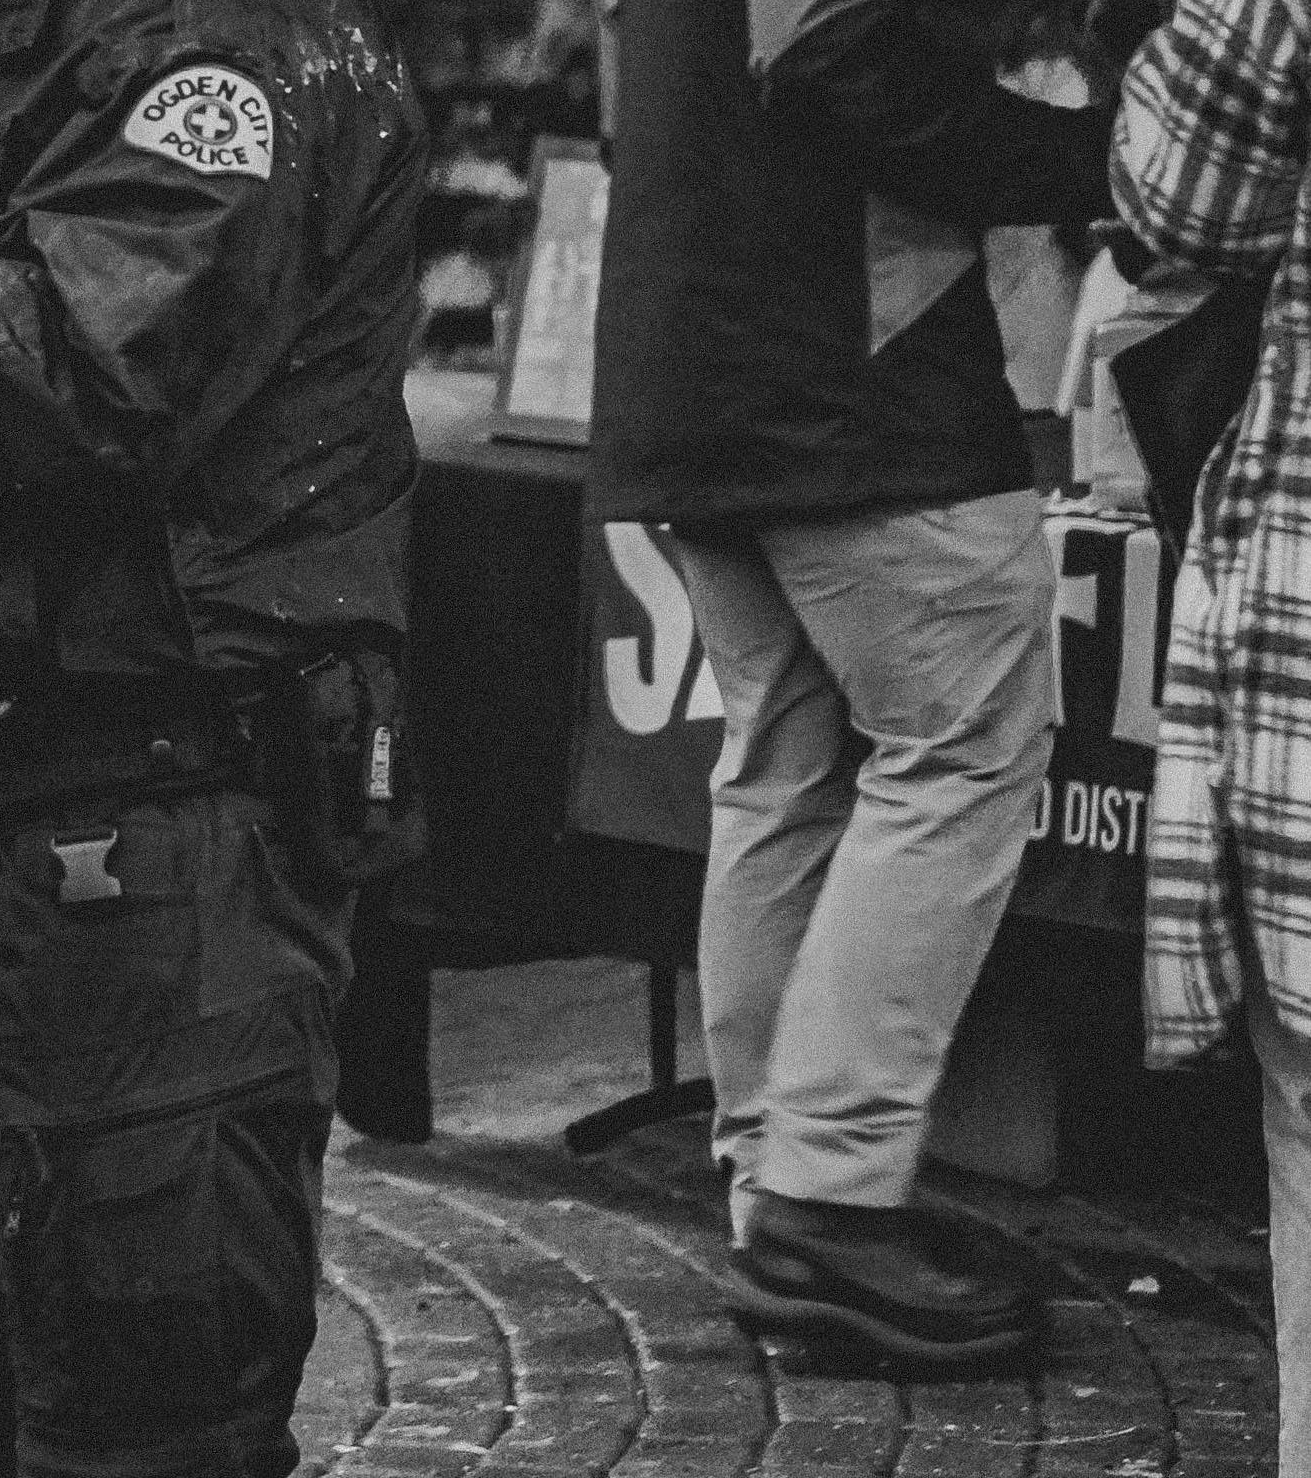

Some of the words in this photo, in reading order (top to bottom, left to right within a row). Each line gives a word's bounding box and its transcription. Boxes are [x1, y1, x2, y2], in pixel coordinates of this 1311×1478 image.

[142, 76, 238, 122] OGDEN
[239, 96, 271, 155] CITY
[159, 131, 250, 166] POLICE
[1064, 782, 1151, 857] DIST
